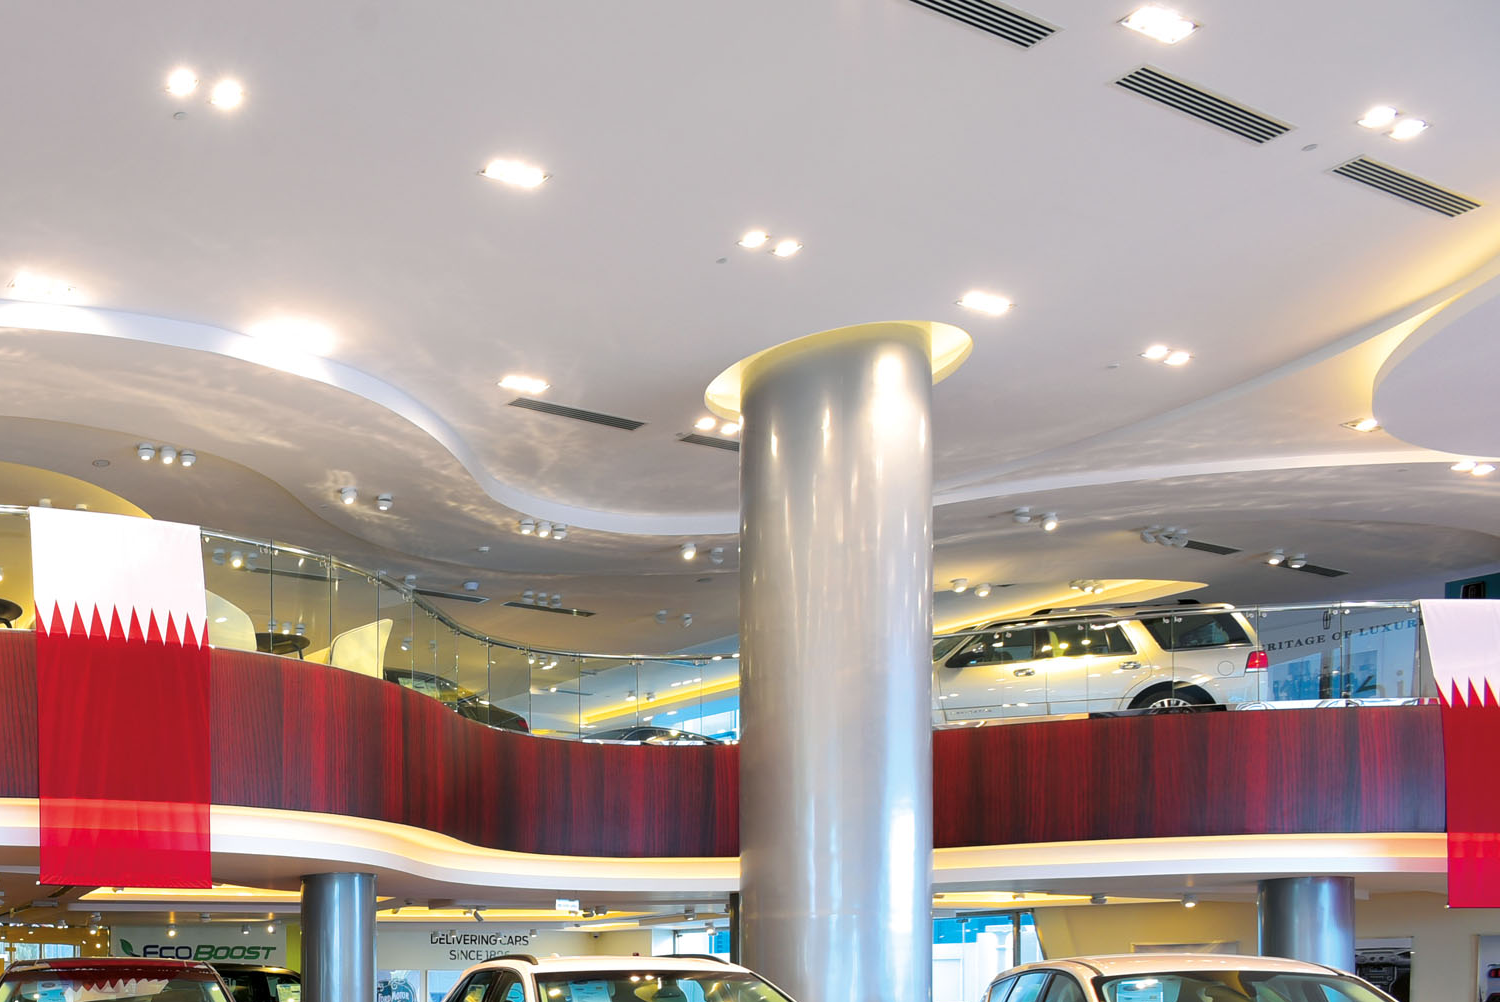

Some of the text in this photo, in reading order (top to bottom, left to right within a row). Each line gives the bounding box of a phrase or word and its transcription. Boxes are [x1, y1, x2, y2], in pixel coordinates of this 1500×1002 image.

[1261, 634, 1326, 651] RITAGE
[1332, 630, 1353, 641] OF
[430, 934, 529, 946] DELIVERING CARS
[449, 949, 483, 961] SINCE
